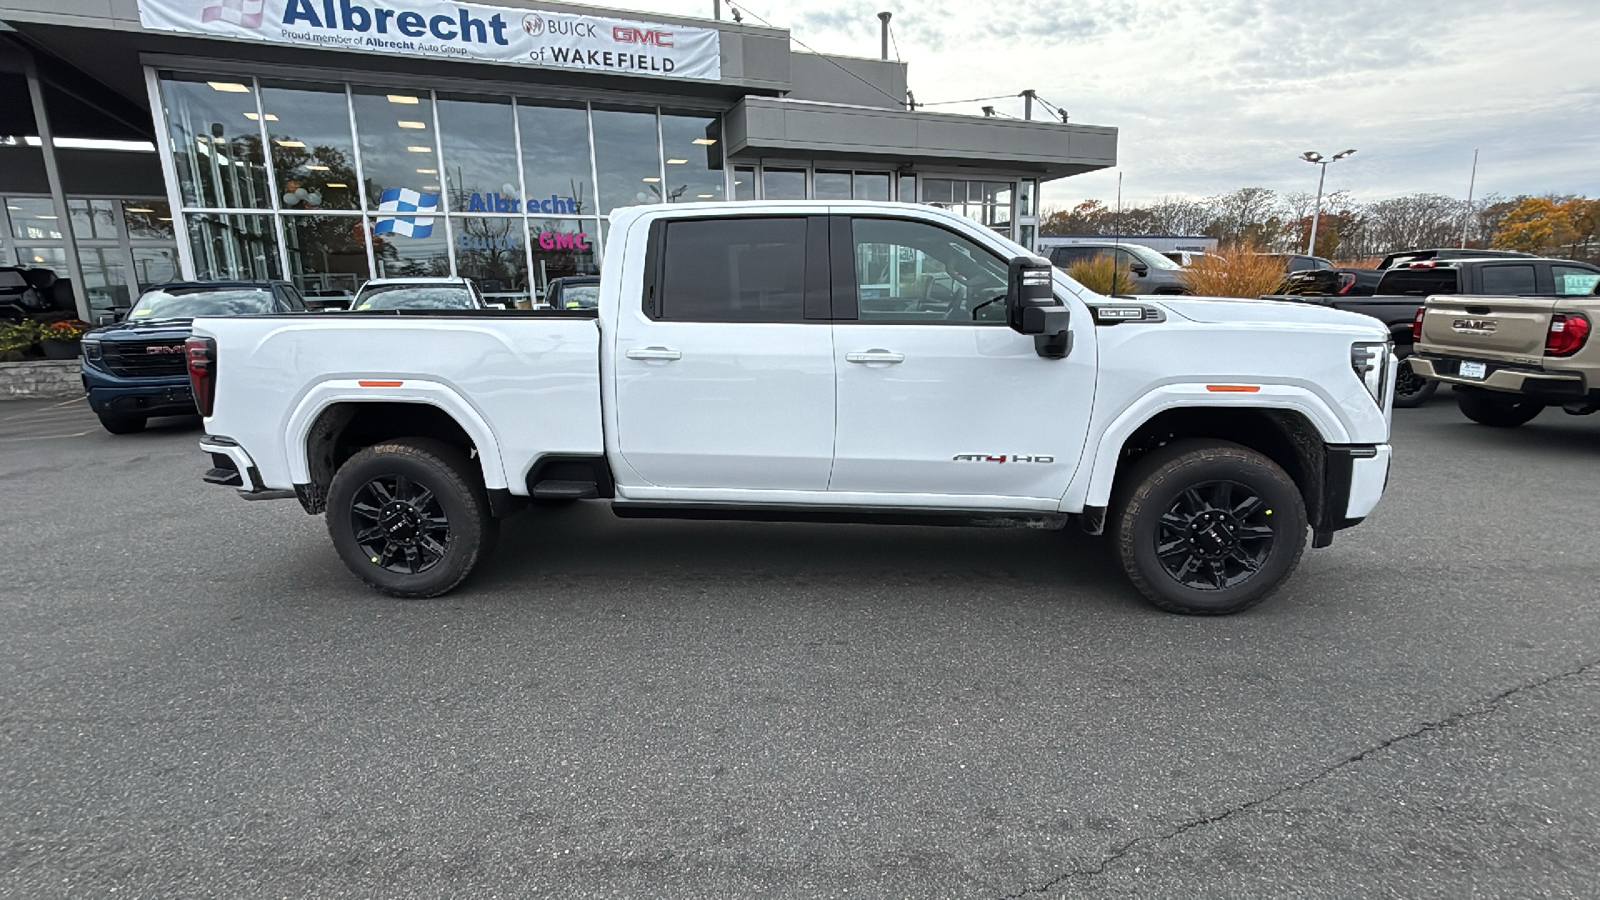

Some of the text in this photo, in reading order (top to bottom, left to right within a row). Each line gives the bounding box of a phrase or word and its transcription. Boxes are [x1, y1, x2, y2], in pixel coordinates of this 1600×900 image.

[282, 0, 509, 46] Albrecht
[548, 19, 674, 48] BUICK GMC
[282, 29, 467, 55] Proud member of Albrecht Auto Group
[530, 47, 675, 72] of WAKEFIELD
[469, 192, 577, 214] Albrecht
[458, 231, 589, 250] Buick GMC
[1453, 319, 1497, 332] GMC
[953, 454, 1054, 463] AT4 HD
